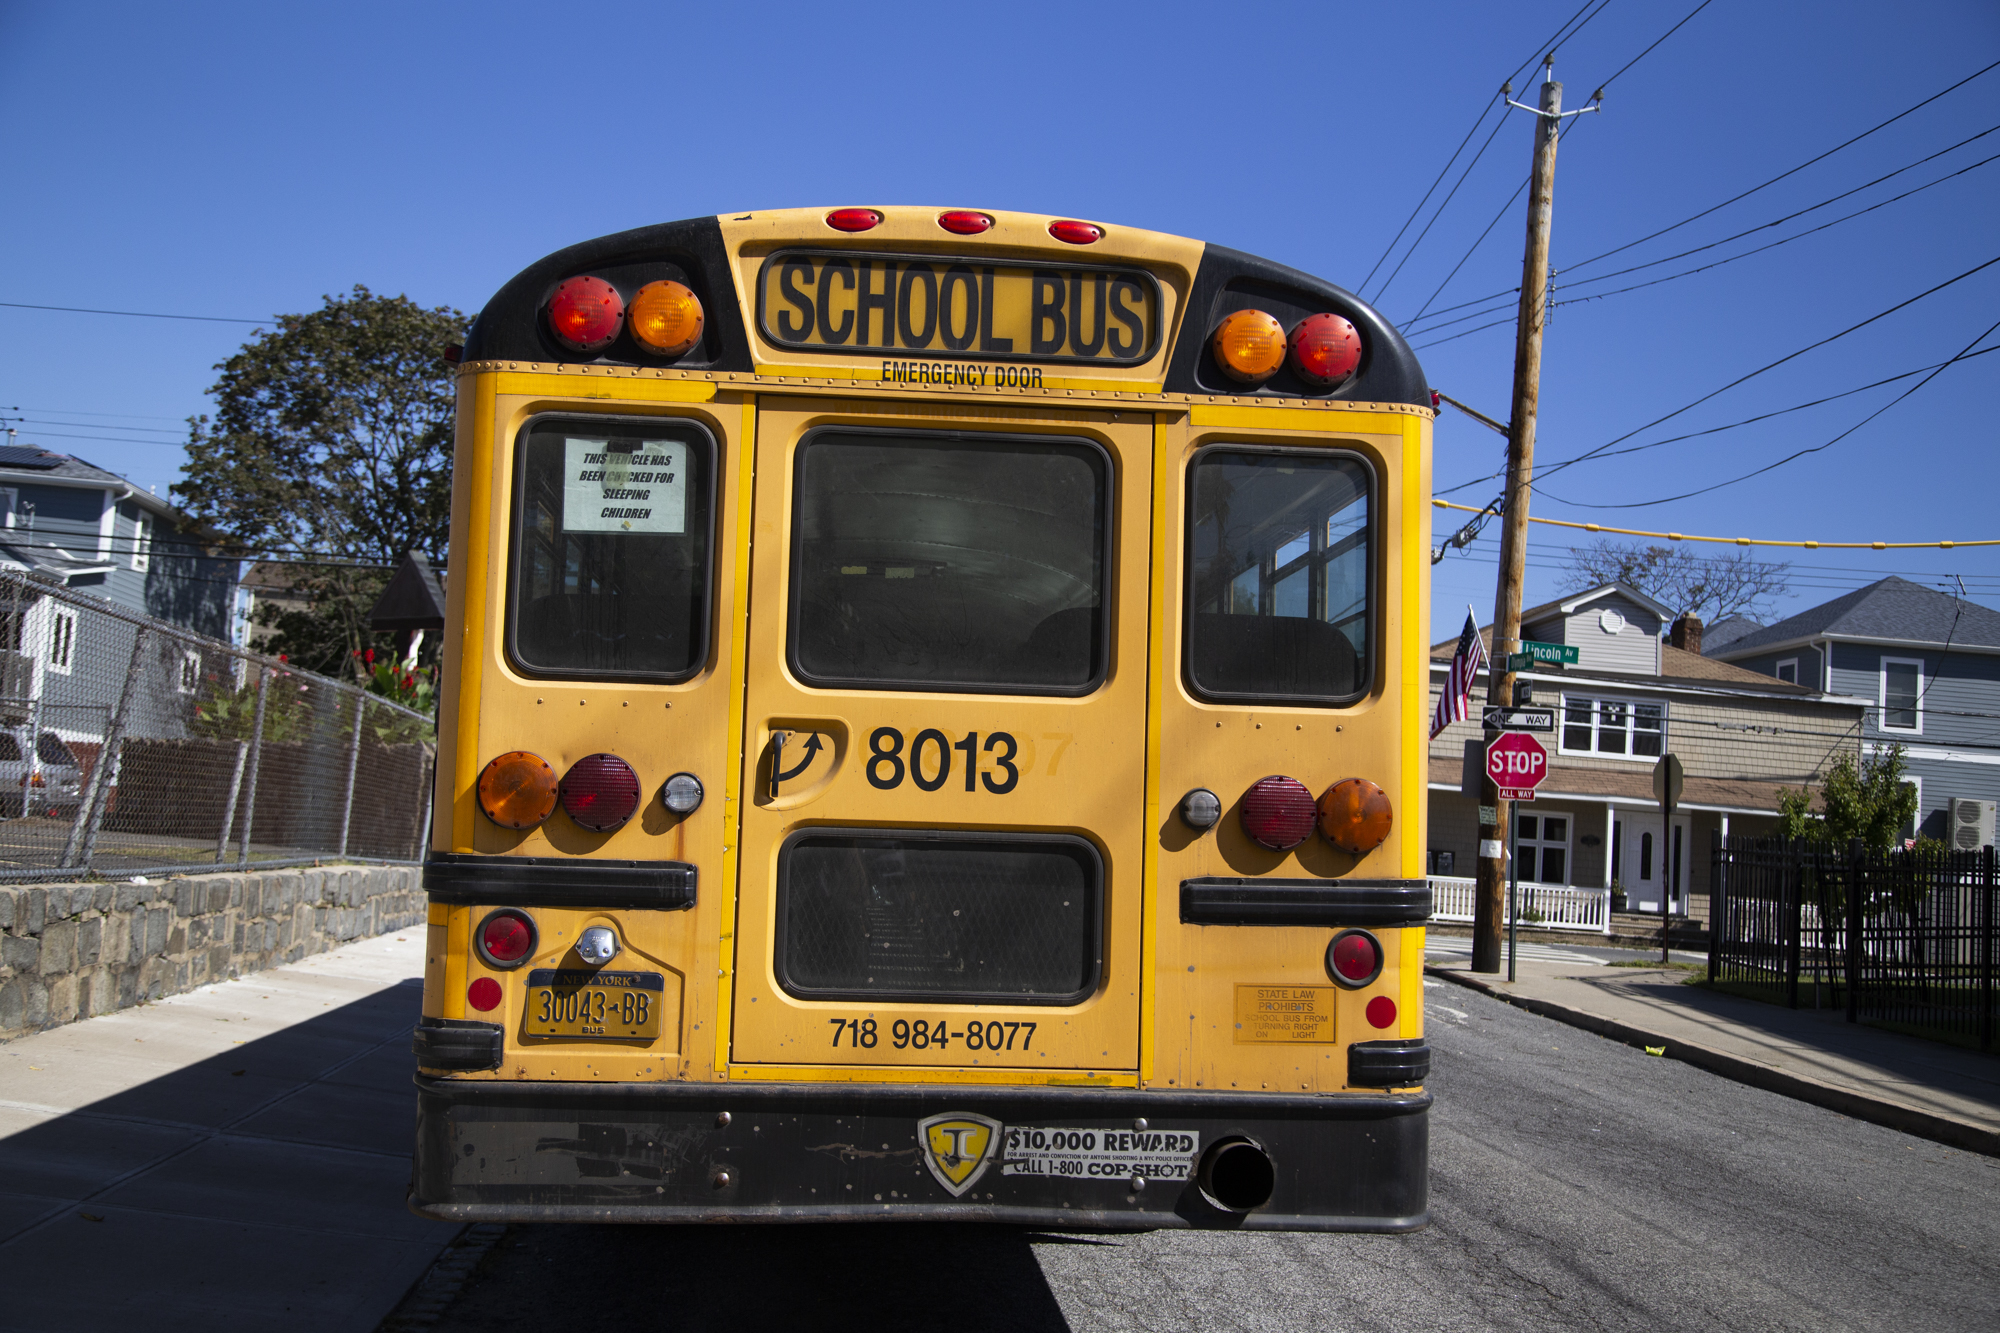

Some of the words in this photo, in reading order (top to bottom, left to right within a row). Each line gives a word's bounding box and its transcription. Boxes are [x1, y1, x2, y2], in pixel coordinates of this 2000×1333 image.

[777, 255, 1013, 352] SCHOOL
[1032, 270, 1143, 358] BUS
[882, 361, 988, 386] EMERGENCY
[995, 366, 1043, 388] DOOR
[583, 453, 607, 464] THIS
[609, 454, 650, 466] VEHICLE
[650, 455, 672, 466] HAS
[579, 471, 606, 481] BEEN
[654, 473, 675, 483] FOR
[603, 489, 650, 500] SLEEPING
[601, 507, 652, 519] CHILDREN
[1565, 648, 1573, 657] Av
[1490, 713, 1513, 724] ONE
[1526, 715, 1547, 724] WAY
[865, 726, 1019, 795] 8013
[1491, 750, 1543, 774] STOP
[1502, 789, 1515, 798] ALL
[1518, 790, 1532, 798] WAY
[563, 974, 594, 985] NEW
[598, 975, 631, 986] YORK
[1257, 989, 1288, 998] STATE
[1293, 990, 1315, 999] LAW
[582, 1026, 605, 1034] BUS
[830, 1018, 878, 1048] 718
[892, 1019, 1037, 1050] 984-8077
[1009, 1128, 1096, 1151] $10,000
[1104, 1133, 1194, 1152] REWARD
[1048, 1160, 1083, 1175] 1-800
[1087, 1162, 1188, 1178] COP-SHOT
